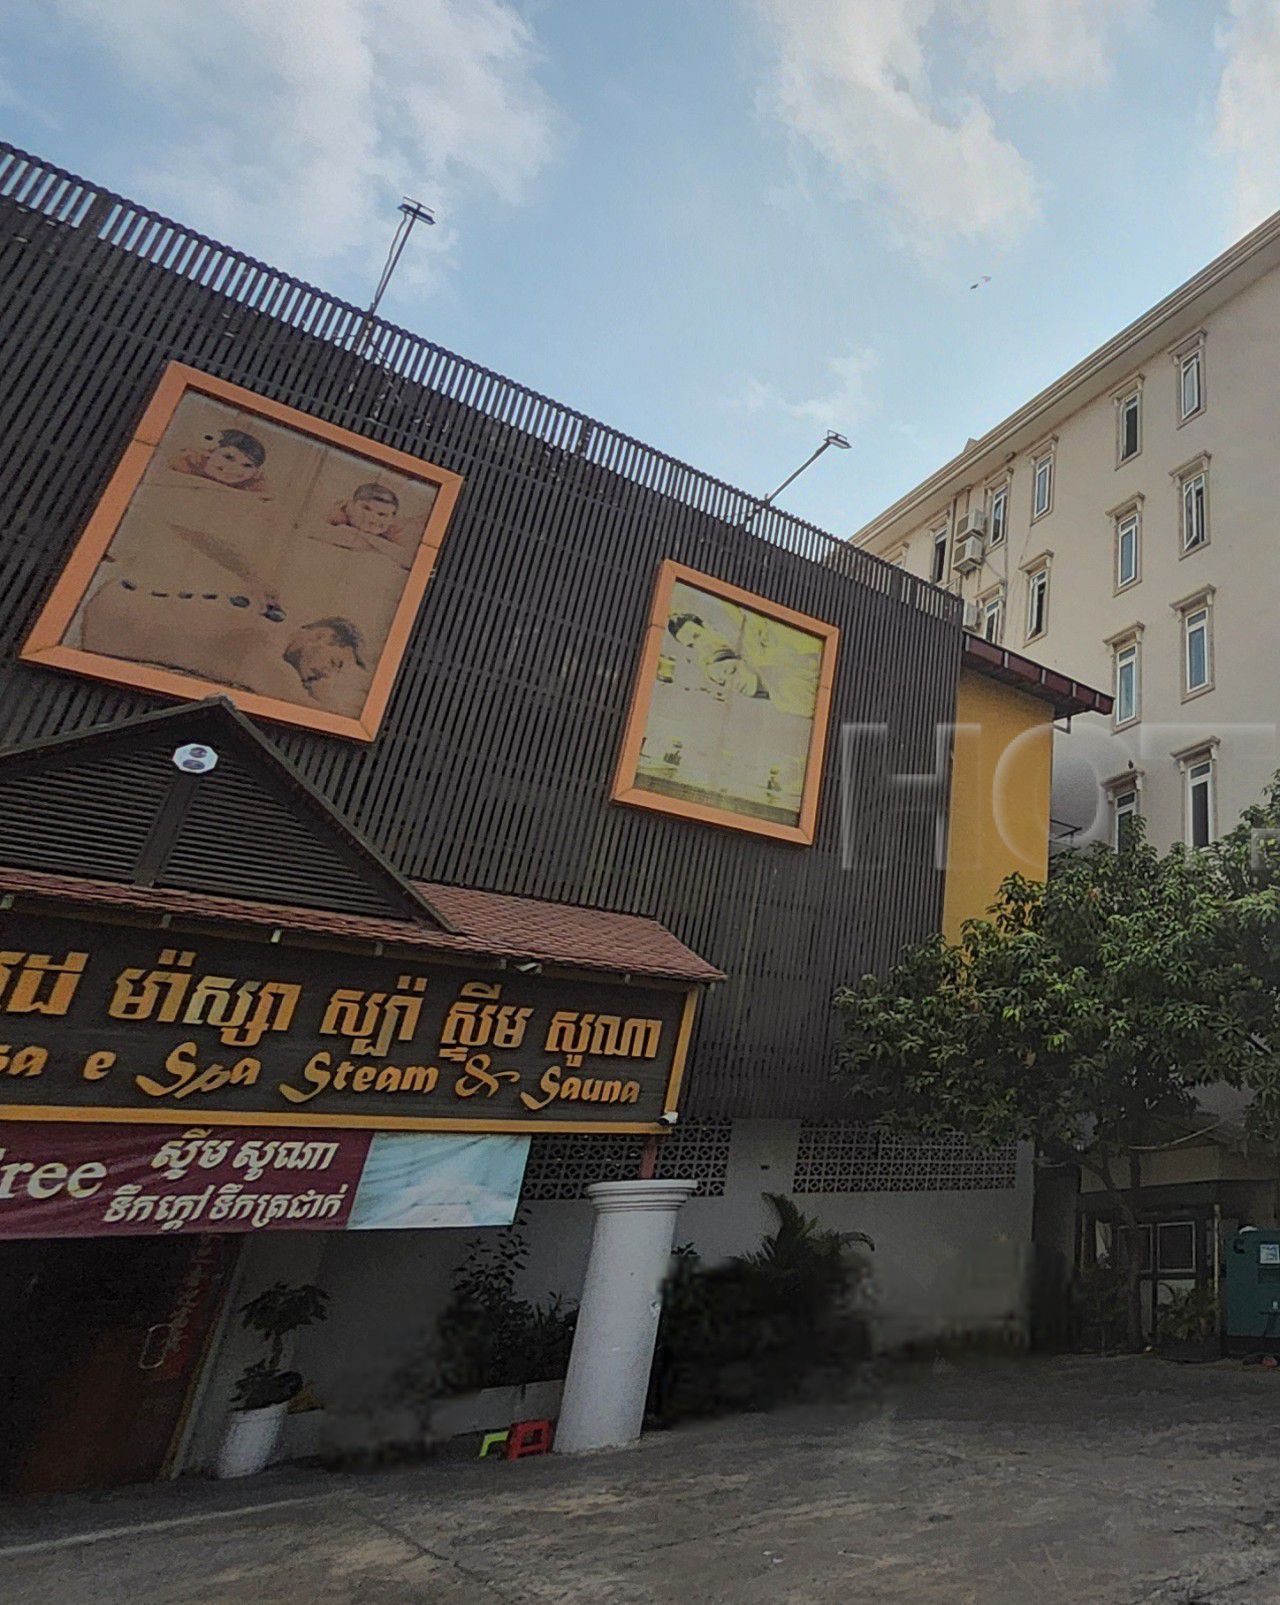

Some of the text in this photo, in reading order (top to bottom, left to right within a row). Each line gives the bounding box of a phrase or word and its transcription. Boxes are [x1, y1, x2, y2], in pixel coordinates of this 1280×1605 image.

[107, 949, 302, 1047] ម៉ាស្សា
[545, 1011, 662, 1067] សូណា
[135, 1042, 262, 1099] Spa
[279, 1051, 440, 1103] Steam
[454, 1053, 521, 1098] &
[520, 1066, 640, 1110] Sauna
[0, 1148, 107, 1199] ree
[233, 1141, 340, 1181] សូណា
